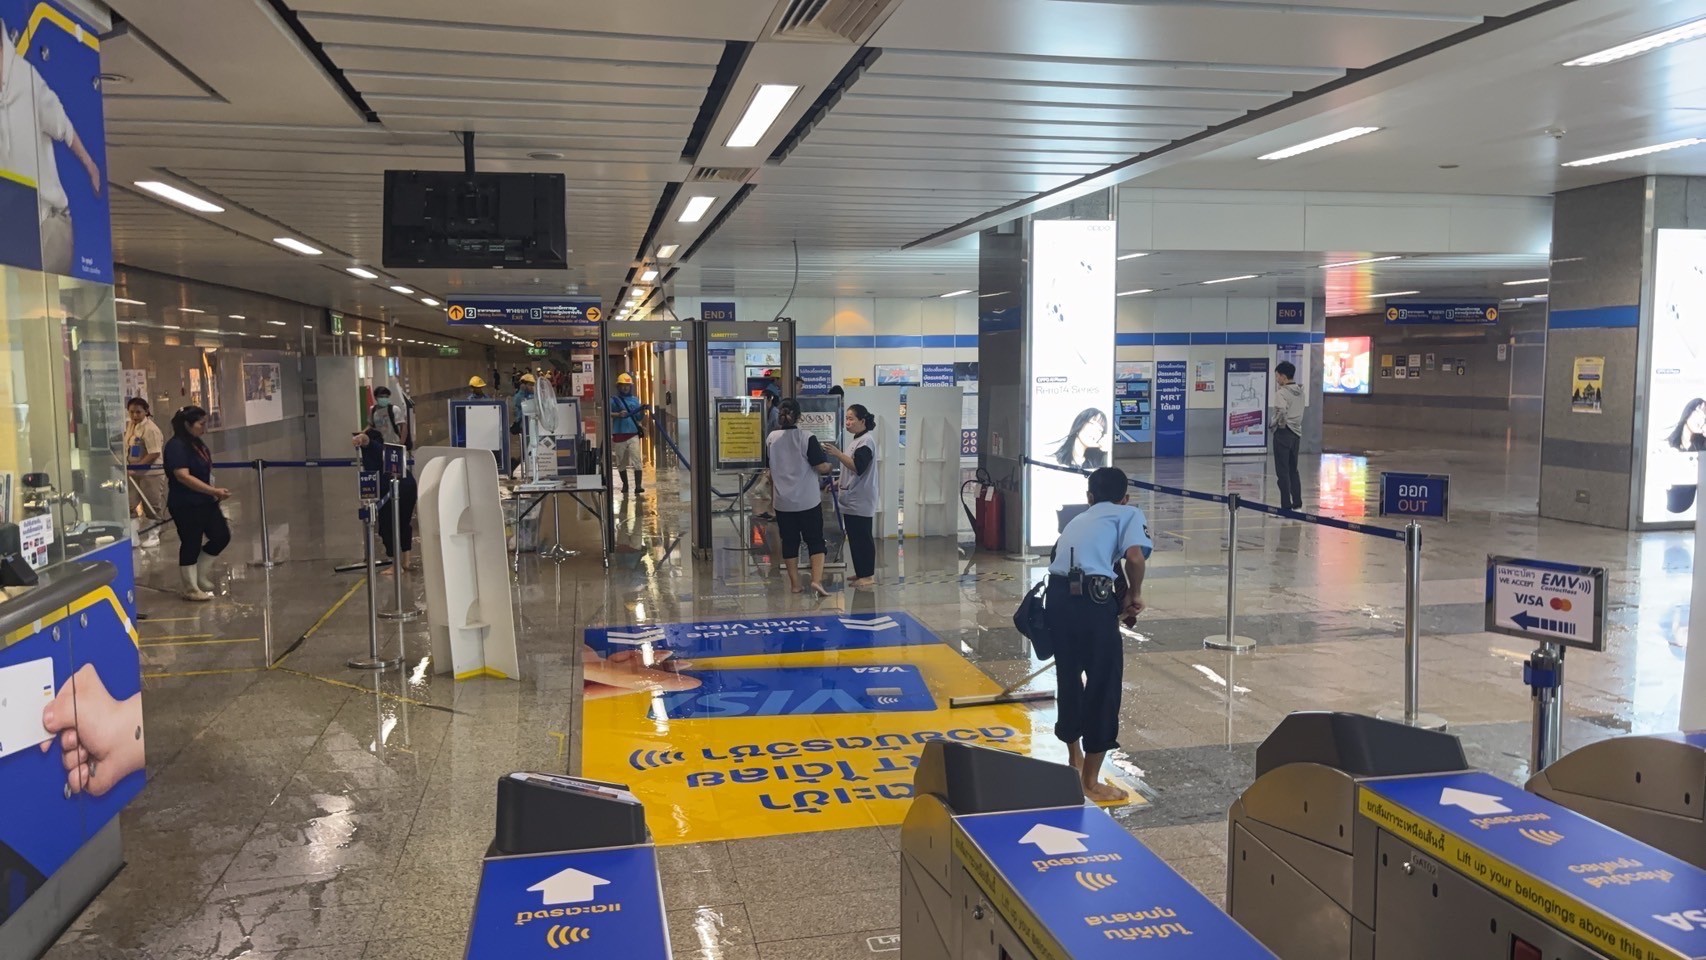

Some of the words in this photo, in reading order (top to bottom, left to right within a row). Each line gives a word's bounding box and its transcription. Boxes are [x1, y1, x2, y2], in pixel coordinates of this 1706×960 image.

[704, 310, 726, 320] END
[728, 310, 733, 319] 1
[1279, 309, 1297, 317] END
[1160, 403, 1181, 411] ได้เลย
[1398, 482, 1429, 498] ออก
[1398, 499, 1428, 513] OUT
[1497, 567, 1536, 579] เฉพาะบัตร
[1511, 579, 1535, 588] ACCEPT
[1541, 573, 1580, 589] EMV
[1541, 585, 1578, 596] Contactless
[1514, 592, 1544, 607] VISA
[694, 623, 748, 631] Visa
[754, 619, 811, 628] with
[780, 626, 829, 635] Tap
[687, 631, 738, 640] ride
[852, 666, 911, 674] VISA
[702, 726, 1016, 764] ด้วยบัตรวีซ่า
[686, 759, 869, 788] ได้เลย
[759, 782, 915, 814] ตะเข้า
[1032, 853, 1123, 873] แตะตรงนี้
[1412, 854, 1437, 875] GAT02
[1457, 848, 1472, 867] Lift
[1474, 862, 1488, 876] up
[1489, 869, 1512, 889] your
[1514, 880, 1576, 924] belongings
[1578, 917, 1617, 946] above
[1620, 936, 1643, 960] this
[515, 902, 622, 926] แตะตรงนี้
[1084, 906, 1177, 927] ทุกคลาส
[1103, 922, 1194, 941] ไปให้ทัน
